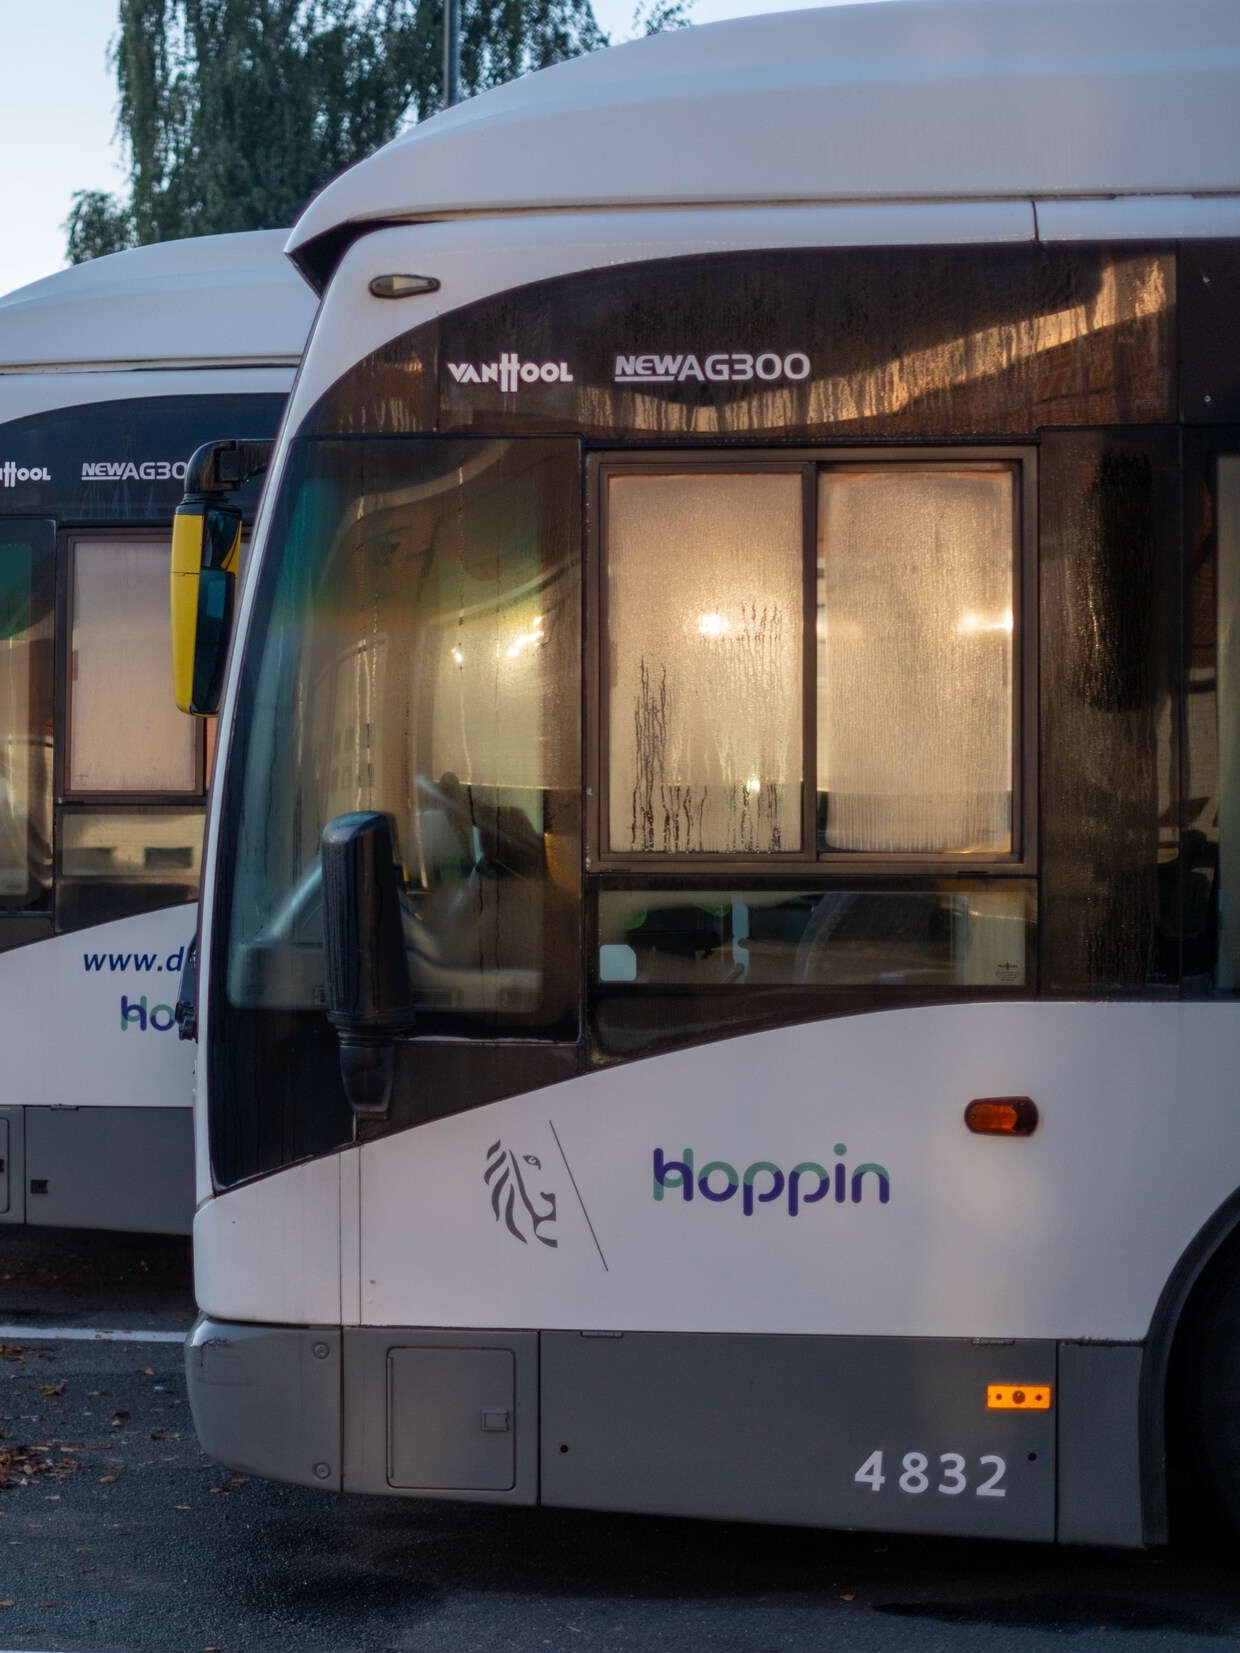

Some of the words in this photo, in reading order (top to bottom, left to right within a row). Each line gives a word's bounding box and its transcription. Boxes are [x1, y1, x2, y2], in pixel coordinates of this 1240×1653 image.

[447, 352, 574, 393] VANHOOL
[81, 461, 187, 481] NEWAG30
[83, 946, 185, 972] www.d
[120, 995, 177, 1031] Ho
[652, 1143, 890, 1217] Hoppin
[854, 1450, 1007, 1498] 4832
